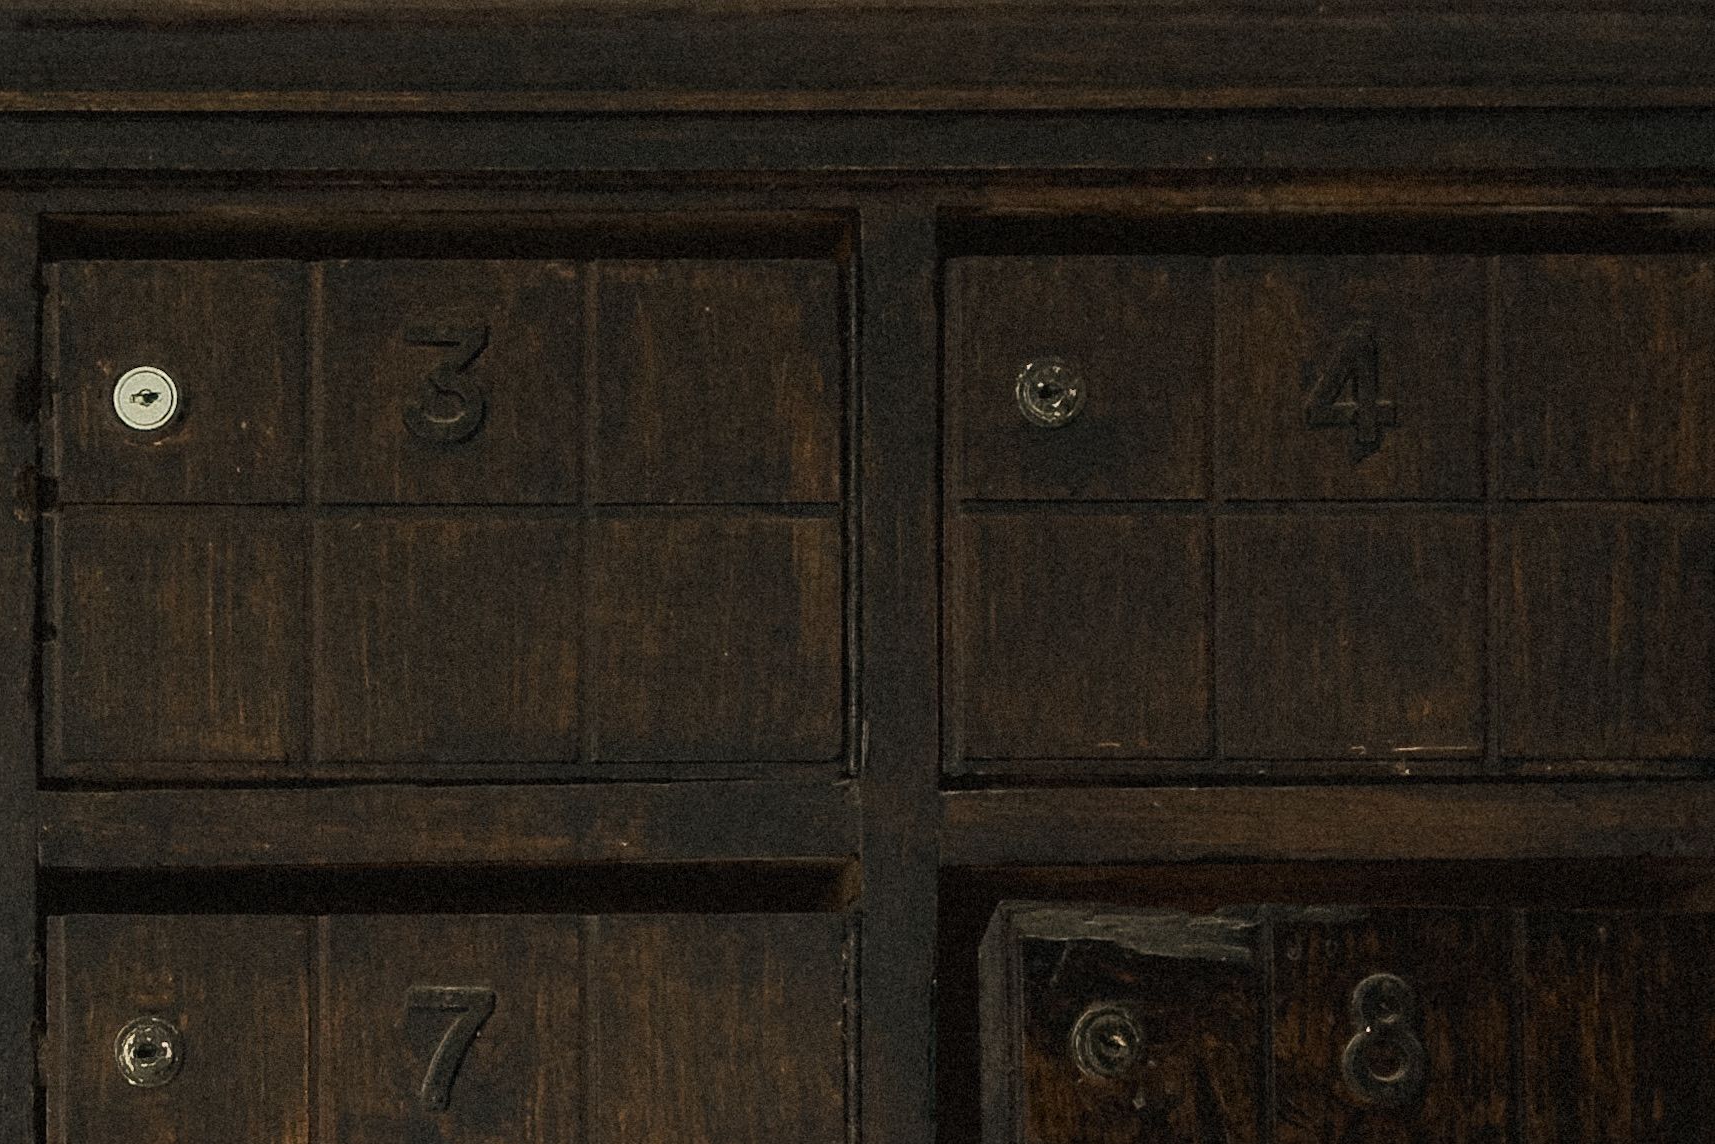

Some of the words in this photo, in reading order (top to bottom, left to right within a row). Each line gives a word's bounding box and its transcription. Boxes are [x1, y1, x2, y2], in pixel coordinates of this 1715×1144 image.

[403, 322, 491, 444] 3
[1304, 330, 1397, 459] 4
[405, 986, 497, 1111] 7
[1341, 972, 1426, 1104] 8
